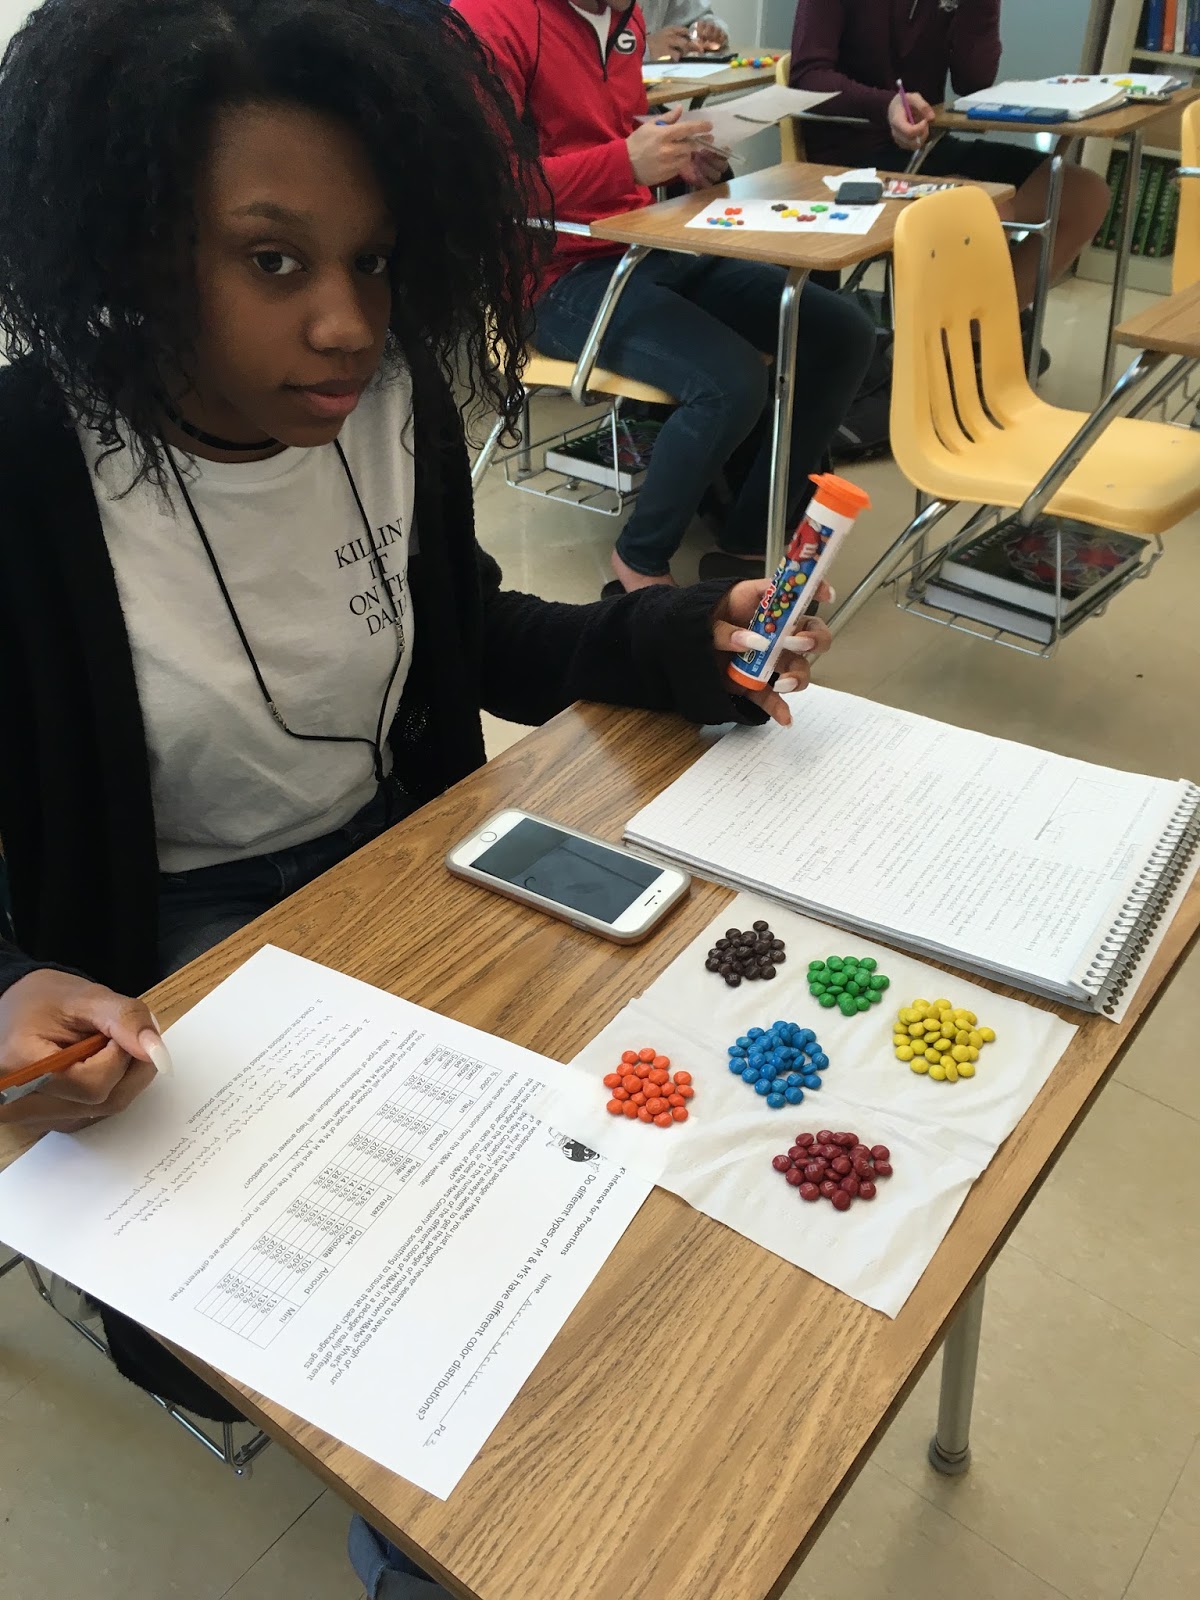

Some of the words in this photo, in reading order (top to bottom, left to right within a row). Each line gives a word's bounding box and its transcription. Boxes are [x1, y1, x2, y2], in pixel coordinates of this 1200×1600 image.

[615, 29, 636, 54] G
[369, 553, 389, 580] IT
[349, 585, 381, 615] ON
[479, 1076, 492, 1090] color
[503, 1071, 518, 1086] Here's
[523, 1077, 533, 1086] the
[491, 1086, 505, 1100] some
[529, 1081, 542, 1093] from
[509, 1086, 525, 1104] correct
[520, 1093, 531, 1103] one
[459, 1099, 474, 1113] Plain
[494, 1103, 511, 1123] number
[504, 1102, 523, 1124] package
[468, 1100, 495, 1128] information
[517, 1112, 528, 1121] the
[457, 1128, 471, 1140] from
[491, 1130, 501, 1139] the
[506, 1121, 520, 1134] Mars
[518, 1123, 528, 1131] Or,
[427, 1129, 448, 1150] Peanut
[478, 1129, 490, 1142] each
[509, 1133, 520, 1144] why
[514, 1126, 536, 1152] wondered
[449, 1141, 460, 1150] the
[467, 1142, 480, 1156] color
[479, 1140, 493, 1152] next,
[486, 1134, 509, 1161] Company?
[437, 1150, 452, 1165] M&M
[491, 1154, 504, 1166] that
[505, 1151, 516, 1163] why
[394, 1157, 413, 1175] Butter
[399, 1161, 421, 1182] Peanut
[449, 1162, 464, 1180] M&M?
[463, 1160, 476, 1173] does
[470, 1169, 481, 1178] the
[483, 1165, 494, 1176] you
[497, 1163, 508, 1172] the
[418, 1165, 439, 1187] website:
[454, 1173, 466, 1183] the
[479, 1172, 499, 1195] package
[583, 1174, 596, 1185] Do
[443, 1183, 458, 1197] Mars
[453, 1178, 472, 1201] number
[467, 1176, 485, 1196] always
[596, 1174, 621, 1204] Inference
[286, 1199, 303, 1214] 23%
[370, 1194, 392, 1217] Pretzel
[447, 1200, 454, 1208] of
[455, 1196, 470, 1211] seem
[474, 1196, 481, 1204] of
[561, 1185, 586, 1216] different
[295, 1203, 311, 1218] 23%
[303, 1209, 318, 1222] 15%
[420, 1197, 446, 1225] Company
[438, 1207, 449, 1218] the
[459, 1203, 476, 1220] M&Ms
[589, 1204, 599, 1215] for
[311, 1213, 327, 1227] 12%
[320, 1218, 336, 1231] 15%
[440, 1218, 451, 1230] get
[449, 1220, 461, 1233] you
[546, 1216, 565, 1237] types
[329, 1222, 344, 1235] 12%
[414, 1225, 423, 1233] do
[417, 1218, 440, 1244] different
[431, 1230, 443, 1241] the
[560, 1215, 592, 1255] Proportions
[218, 1226, 240, 1249] sample
[252, 1235, 269, 1250] 20%
[322, 1225, 353, 1258] Chocolate
[345, 1229, 362, 1245] Dark
[439, 1232, 452, 1245] just
[540, 1237, 549, 1248] of
[208, 1248, 220, 1259] are
[260, 1240, 278, 1255] 20%
[269, 1244, 286, 1260] 20%
[387, 1234, 416, 1265] something
[402, 1244, 419, 1262] colors
[411, 1240, 434, 1266] package
[532, 1247, 543, 1256] M
[278, 1250, 294, 1264] 10%
[286, 1253, 303, 1269] 20%
[422, 1245, 443, 1267] bought
[184, 1259, 209, 1286] different
[295, 1259, 311, 1273] 10%
[382, 1265, 391, 1273] to
[397, 1262, 404, 1271] of
[406, 1266, 413, 1275] of
[516, 1264, 531, 1279] M's
[216, 1273, 234, 1289] 25%
[303, 1266, 329, 1294] Almond
[365, 1273, 385, 1293] insure
[380, 1270, 399, 1290] M&Ms
[408, 1267, 424, 1286] never
[533, 1273, 552, 1294] Name
[225, 1278, 243, 1294] 25%
[234, 1284, 250, 1299] 12%
[387, 1274, 407, 1296] mostly
[501, 1279, 521, 1299] have
[169, 1286, 185, 1301] than
[242, 1289, 259, 1303] 12%
[353, 1293, 368, 1308] that
[390, 1286, 409, 1307] seems
[251, 1294, 268, 1309] 13%
[260, 1299, 277, 1313] 13%
[371, 1296, 391, 1317] brown
[279, 1307, 295, 1323] Mini
[340, 1307, 355, 1324] each
[347, 1302, 371, 1331] package
[384, 1307, 393, 1315] to
[474, 1300, 504, 1336] different
[353, 1317, 373, 1342] M&Ms?
[370, 1315, 387, 1332] have
[316, 1323, 342, 1352] package
[331, 1331, 348, 1350] really
[350, 1333, 372, 1358] enough
[459, 1336, 477, 1359] color
[303, 1352, 318, 1369] gets
[329, 1345, 354, 1369] What's
[343, 1359, 351, 1369] of
[306, 1351, 332, 1381] different
[330, 1367, 345, 1385] your
[416, 1359, 461, 1420] distributions?
[433, 1423, 446, 1436] Pd
